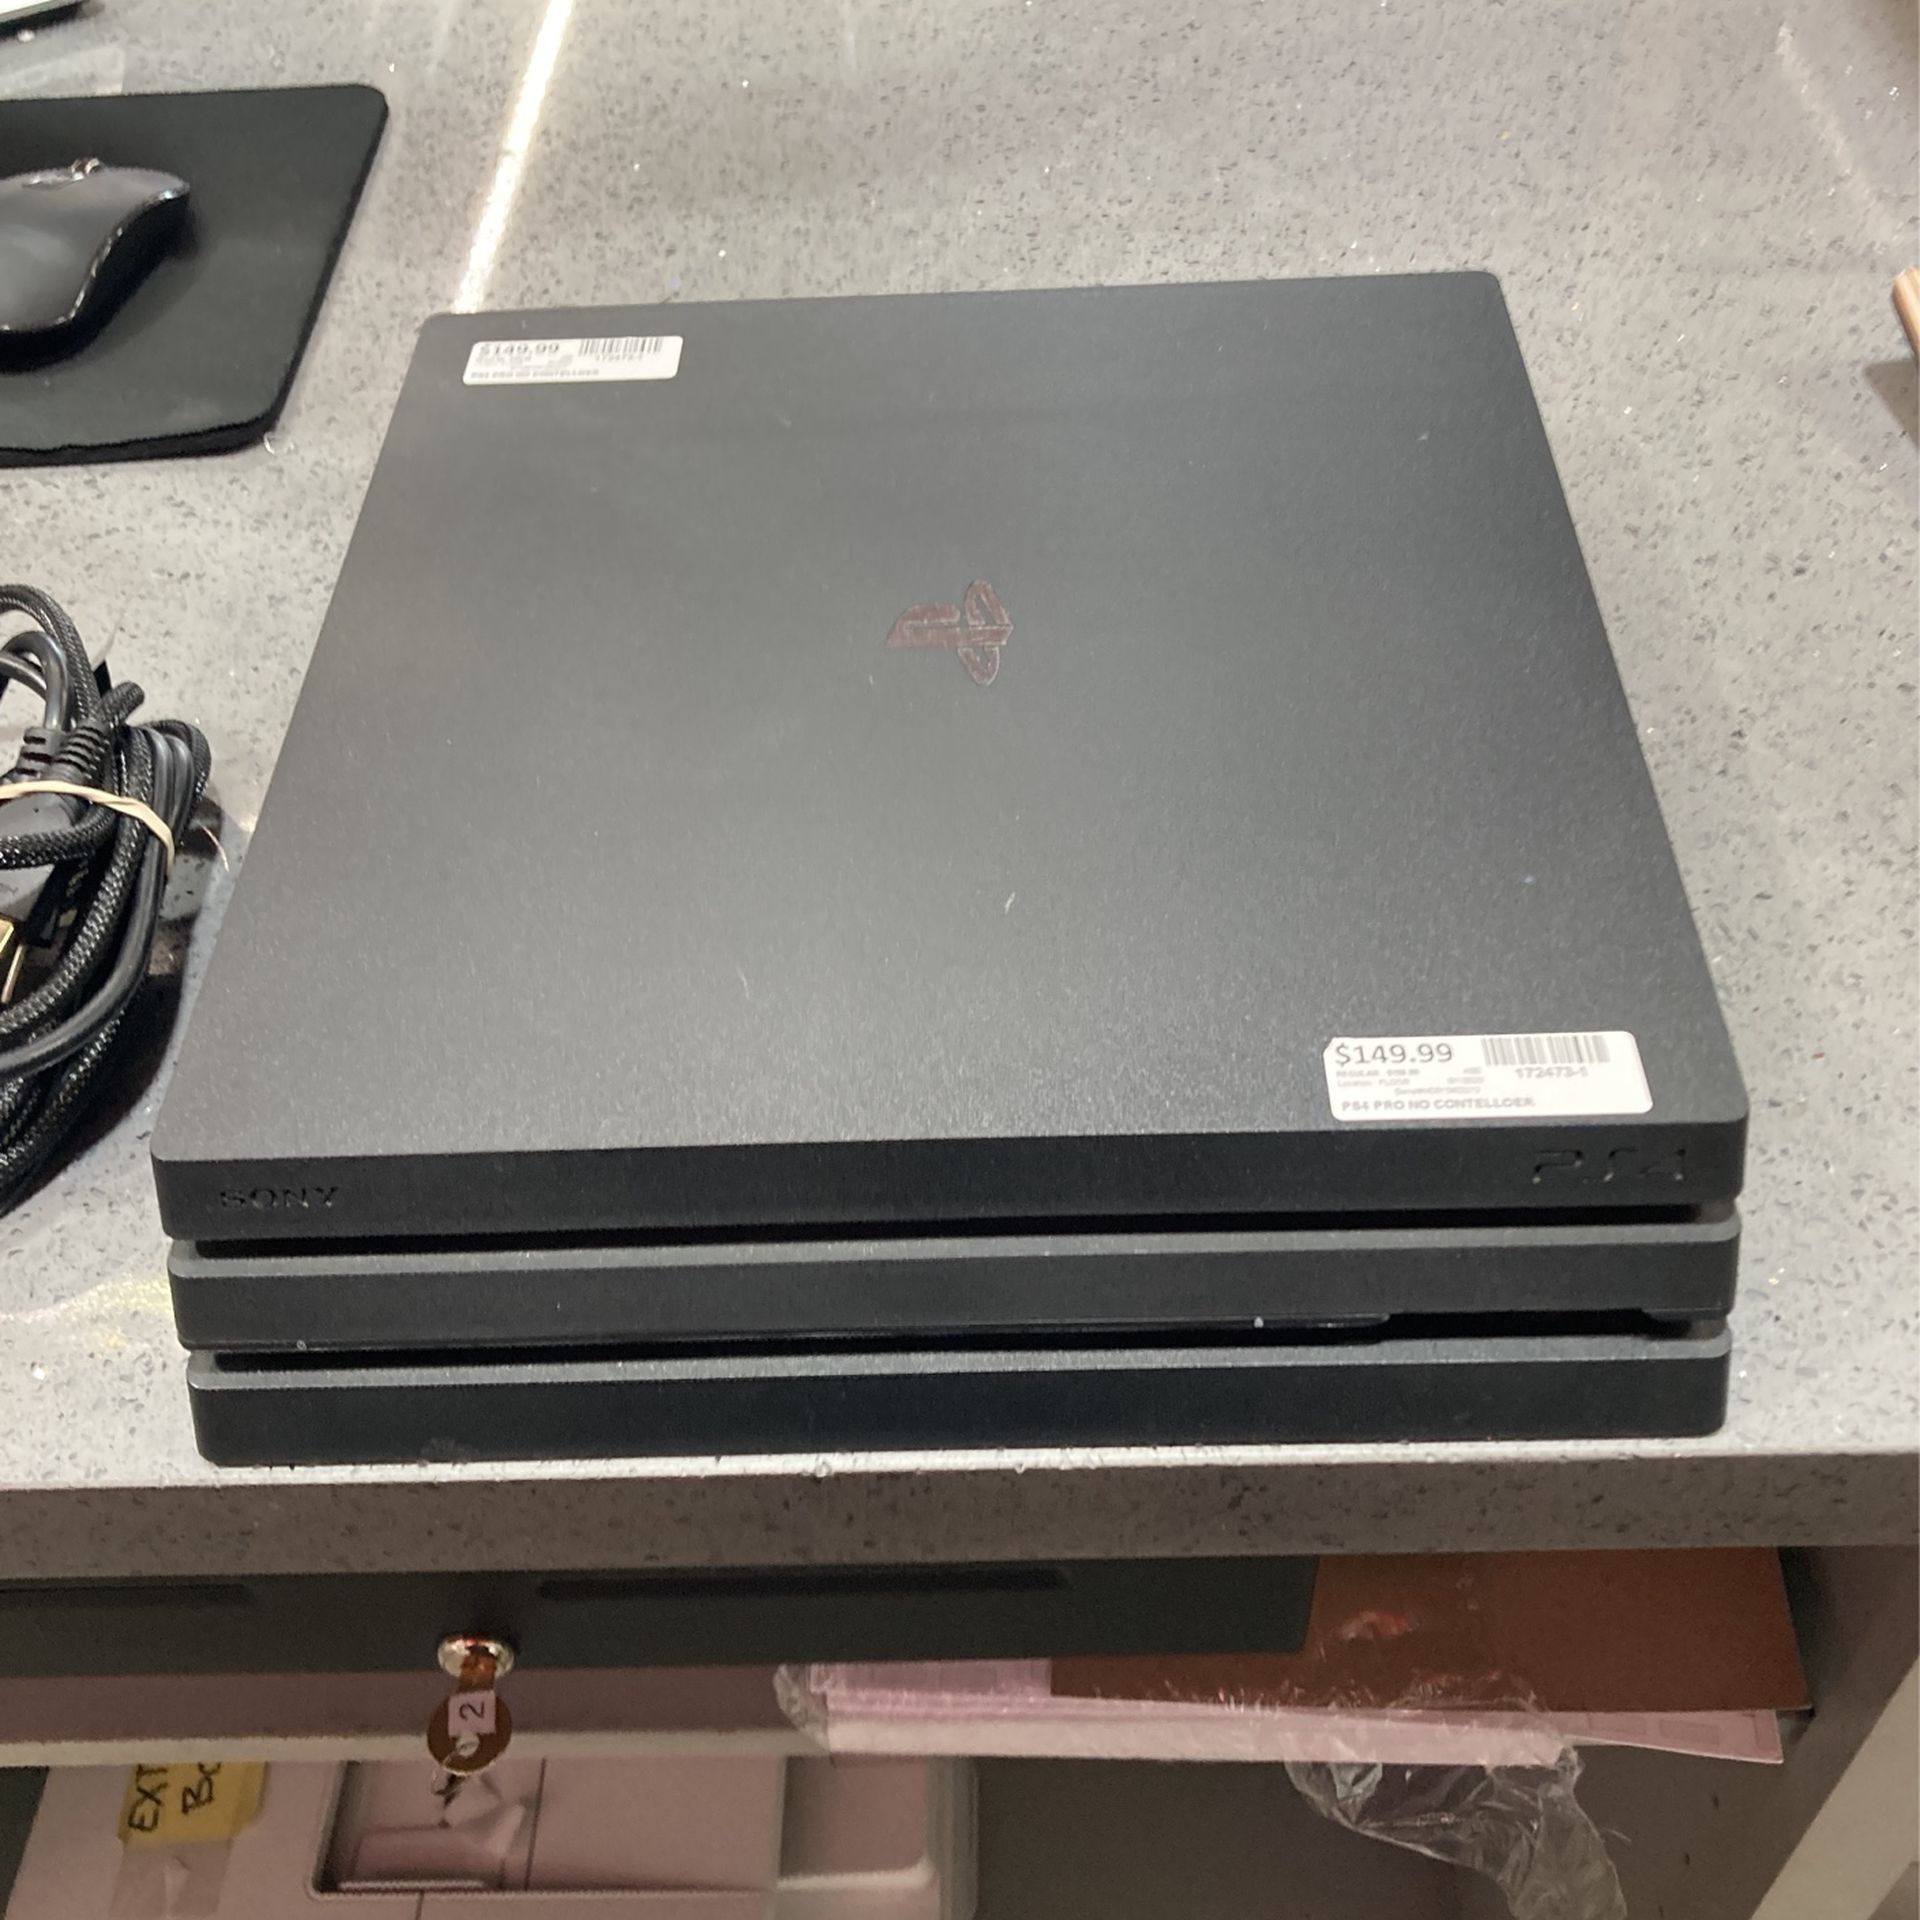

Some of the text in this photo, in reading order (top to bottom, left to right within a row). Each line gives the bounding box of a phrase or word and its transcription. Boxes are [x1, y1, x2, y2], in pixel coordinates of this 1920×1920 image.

[479, 341, 560, 357] $149.99
[1335, 1042, 1453, 1067] $149.99
[1341, 1101, 1370, 1111] PS4
[1373, 1100, 1405, 1111] PRO
[1408, 1099, 1430, 1110] NO
[1531, 1146, 1686, 1185] PS4
[219, 1186, 338, 1208] SONY
[459, 1701, 485, 1721] 2
